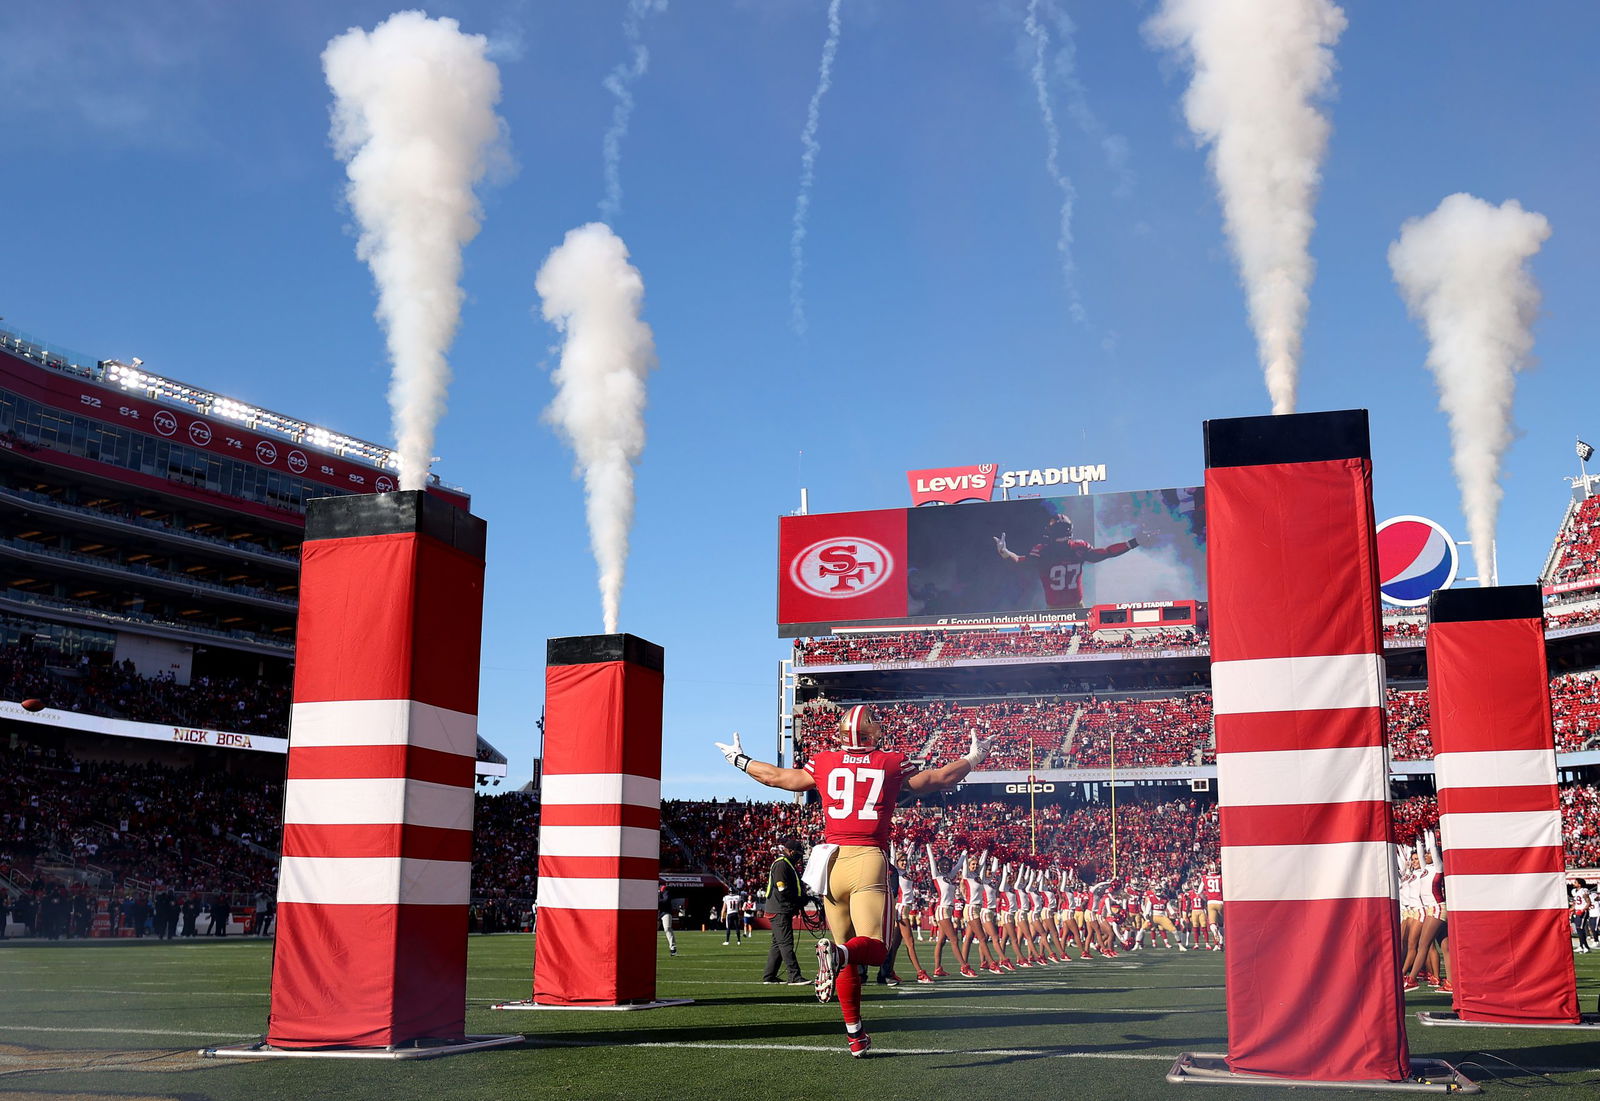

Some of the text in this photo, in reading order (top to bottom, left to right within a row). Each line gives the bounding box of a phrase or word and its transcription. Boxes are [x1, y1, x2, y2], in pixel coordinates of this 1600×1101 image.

[1001, 464, 1106, 488] STADIUM
[1050, 563, 1081, 591] 97
[993, 614, 1037, 623] Industrial
[1039, 612, 1076, 622] Internet
[173, 728, 253, 748] NICK BOSA
[842, 754, 871, 763] BOSA
[827, 767, 885, 820] 97
[1005, 783, 1055, 794] GEICO
[1207, 879, 1221, 893] 91
